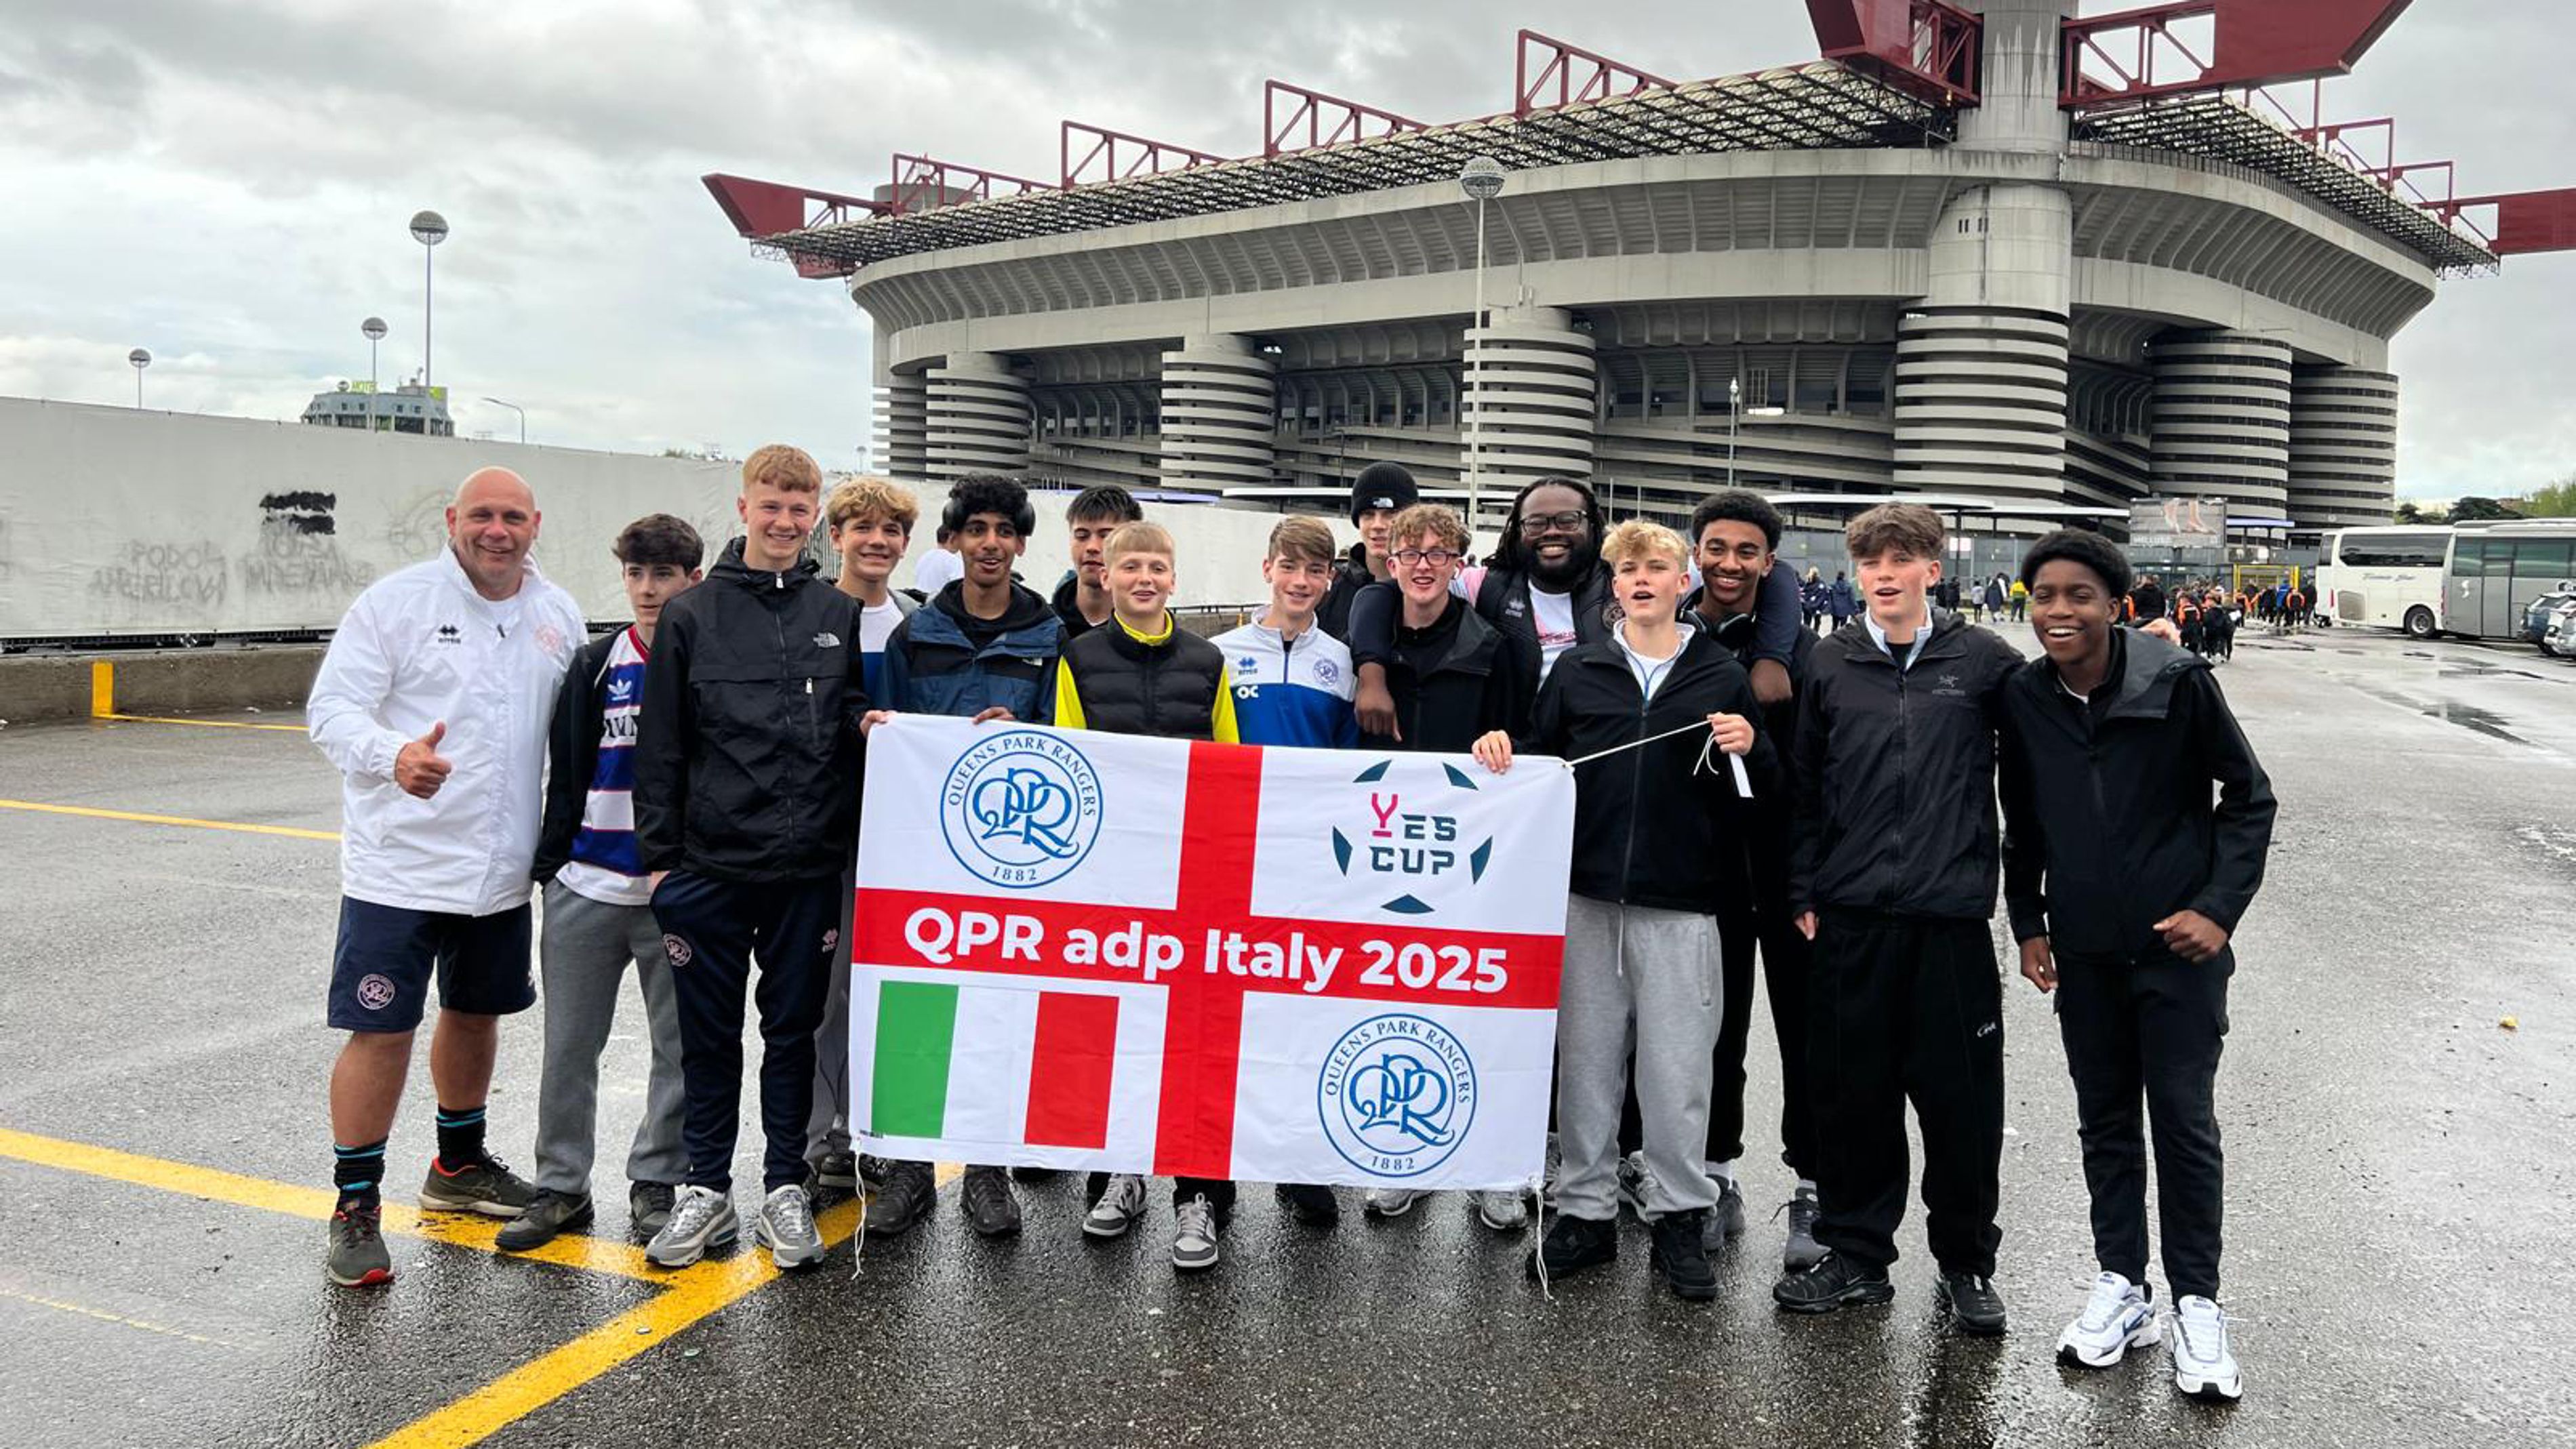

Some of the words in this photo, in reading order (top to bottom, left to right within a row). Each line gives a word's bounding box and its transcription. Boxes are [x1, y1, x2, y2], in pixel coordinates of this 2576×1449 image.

[1236, 685, 1259, 699] OC
[949, 743, 997, 806] QUEENS
[1003, 736, 1048, 752] PARK
[1051, 744, 1096, 817] RANGERS
[1371, 792, 1457, 842] YES
[992, 865, 1037, 882] 1882
[1368, 846, 1455, 876] CUP
[904, 907, 1045, 964] QPR
[1062, 920, 1185, 981] adp
[1204, 928, 1344, 993] Italy
[1359, 939, 1508, 993] 2025
[1325, 1029, 1372, 1096] QUEENS
[1376, 1020, 1420, 1036] PARK
[1426, 1029, 1471, 1104] RANGERS
[1371, 1155, 1415, 1171] 1882
